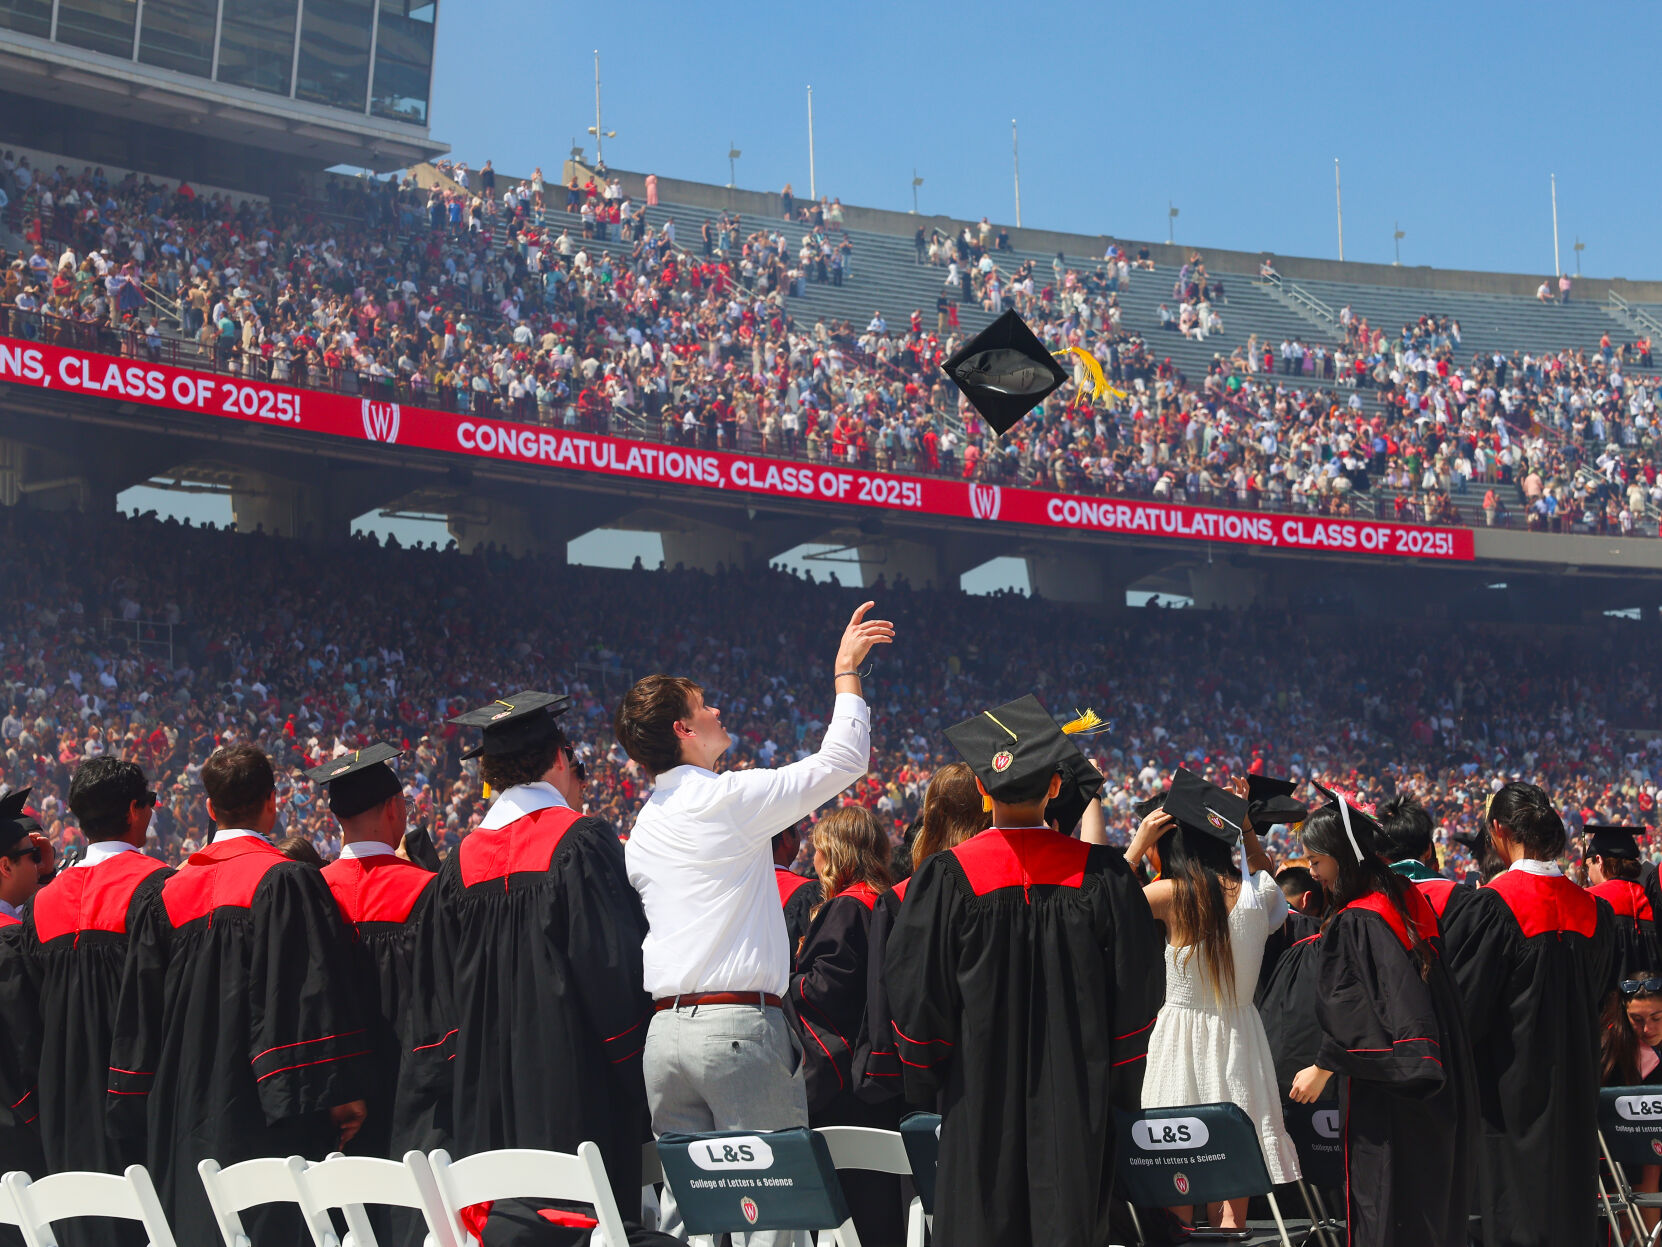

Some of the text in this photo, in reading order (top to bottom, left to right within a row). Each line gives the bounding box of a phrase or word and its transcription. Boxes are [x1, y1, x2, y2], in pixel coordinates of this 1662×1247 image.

[58, 355, 166, 400] CLASS
[172, 375, 216, 407] OF
[221, 383, 301, 423] 2025!
[456, 422, 922, 507] CONGRATULATIONS, CLASS OF 2025!
[1047, 498, 1454, 555] CONGRATULATIONS, CLASS OF 2025!
[1147, 1124, 1192, 1143] L&S
[706, 1145, 755, 1162] L&S
[1129, 1153, 1226, 1167] College of Letters & Science
[690, 1177, 794, 1190] College of Letters & Science
